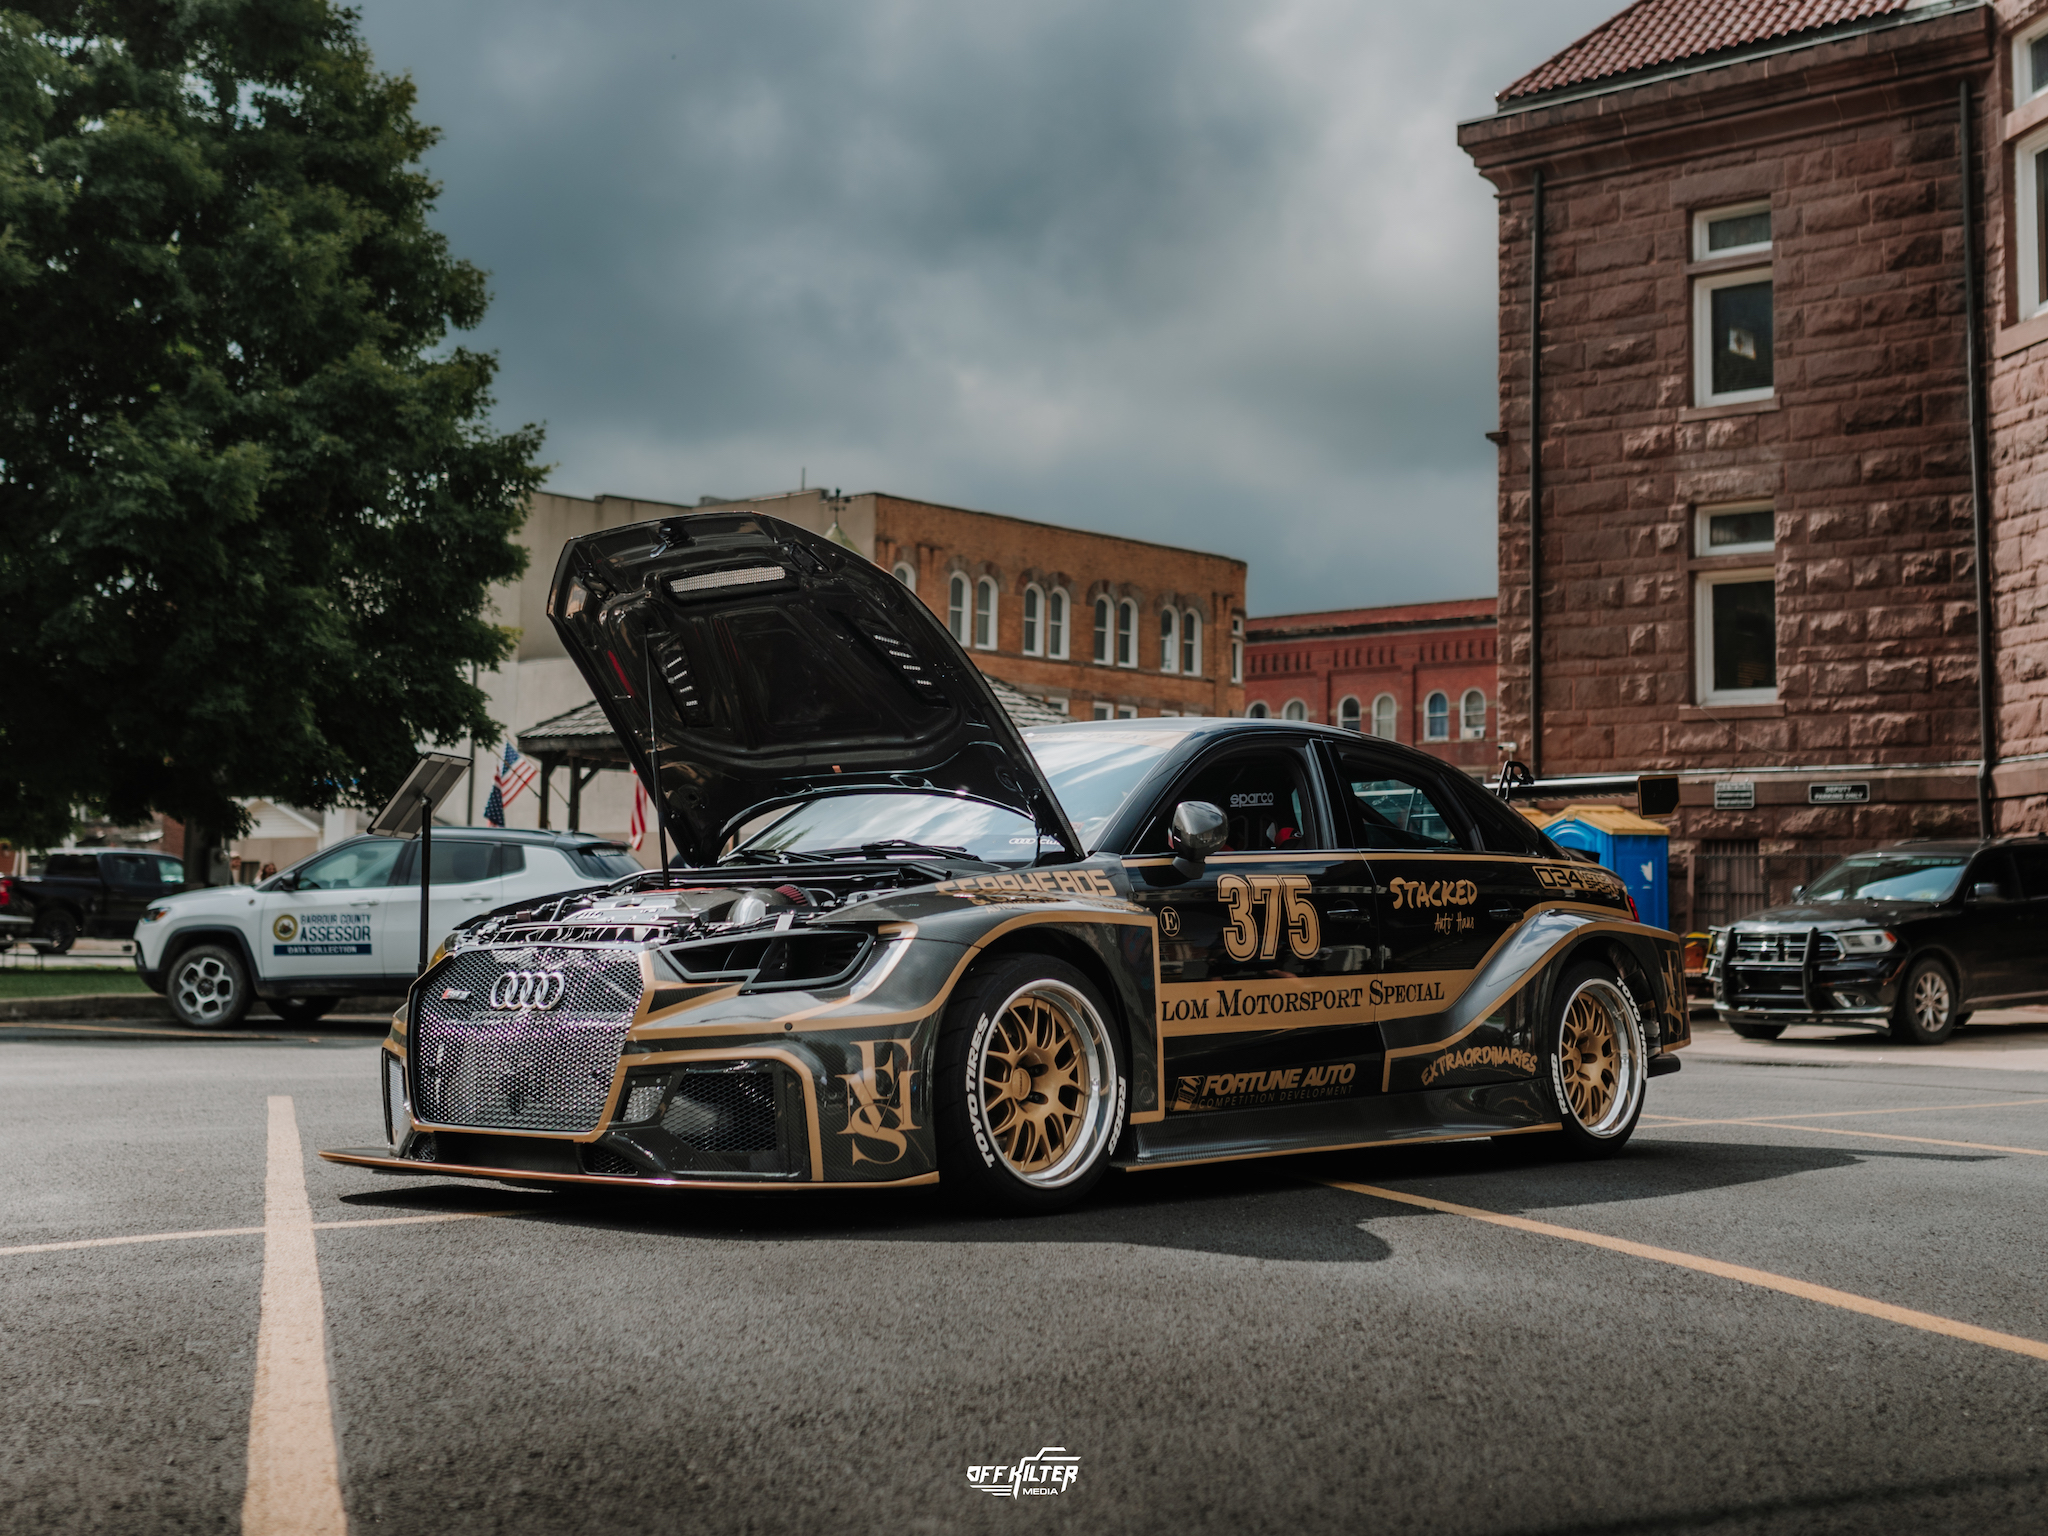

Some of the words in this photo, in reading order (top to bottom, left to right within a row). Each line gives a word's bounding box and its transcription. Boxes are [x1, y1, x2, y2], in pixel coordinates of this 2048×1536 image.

[1039, 838, 1061, 846] Clu
[1535, 867, 1585, 889] 034
[1389, 876, 1478, 909] STACKED
[300, 914, 338, 925] BARBOUR
[340, 914, 371, 924] COUNTY
[1162, 911, 1178, 931] E
[1217, 873, 1321, 962] 375
[300, 926, 371, 941] ASSESSOR
[287, 945, 307, 954] DATA
[308, 945, 357, 954] COLLECTION
[1617, 976, 1641, 1021] TOYO
[965, 1012, 989, 1092] TIRES
[1202, 1068, 1303, 1097] FORTUNE
[1301, 1063, 1356, 1088] AUTO
[1200, 1093, 1275, 1109] COMPETITION
[1280, 1085, 1354, 1101] DEVELOPMENT
[1108, 1075, 1127, 1156] R888
[966, 1092, 995, 1168] TOYO
